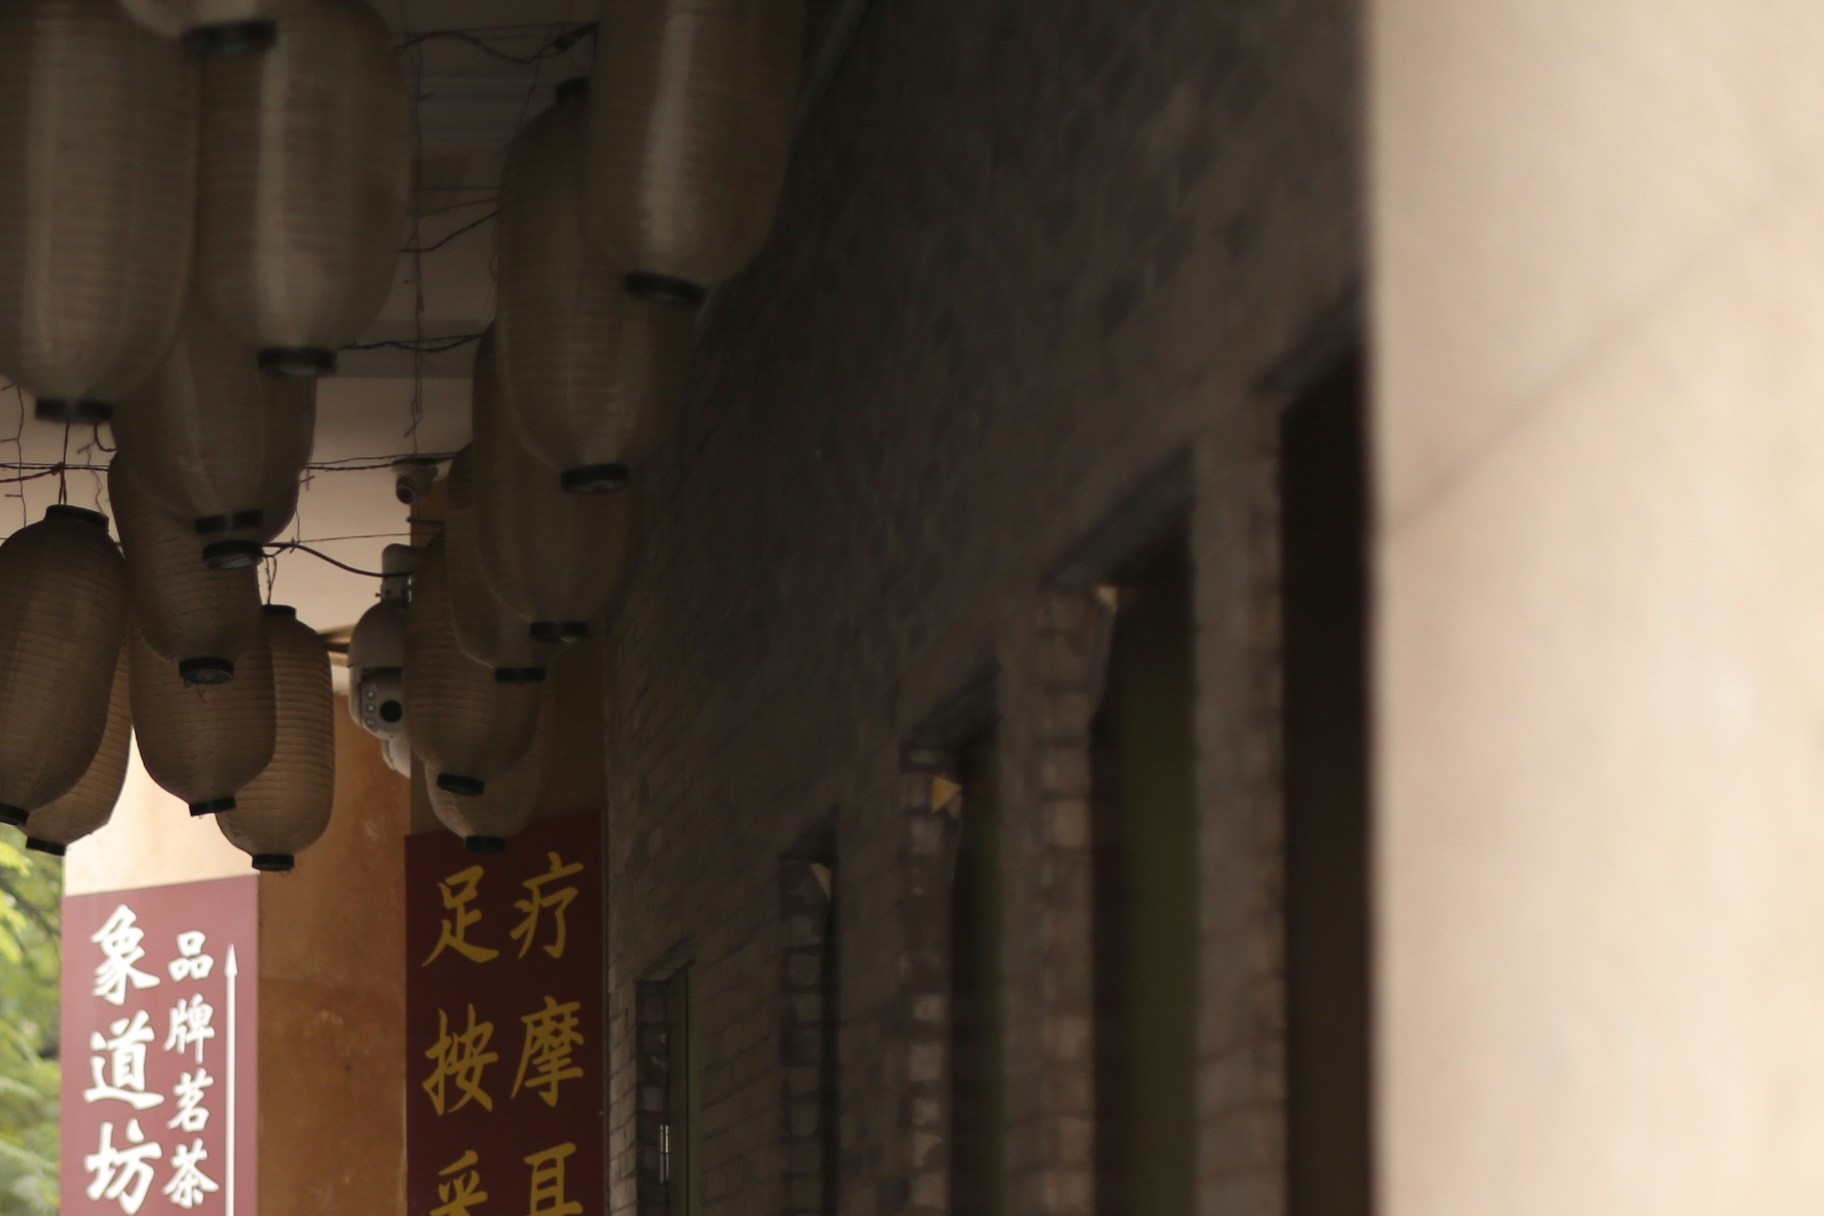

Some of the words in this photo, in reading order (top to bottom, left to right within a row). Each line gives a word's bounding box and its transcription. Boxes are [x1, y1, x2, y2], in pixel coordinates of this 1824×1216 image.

[422, 852, 584, 967] 足疗
[163, 930, 219, 1208] 品牌茗茶
[422, 996, 584, 1116] 按摩
